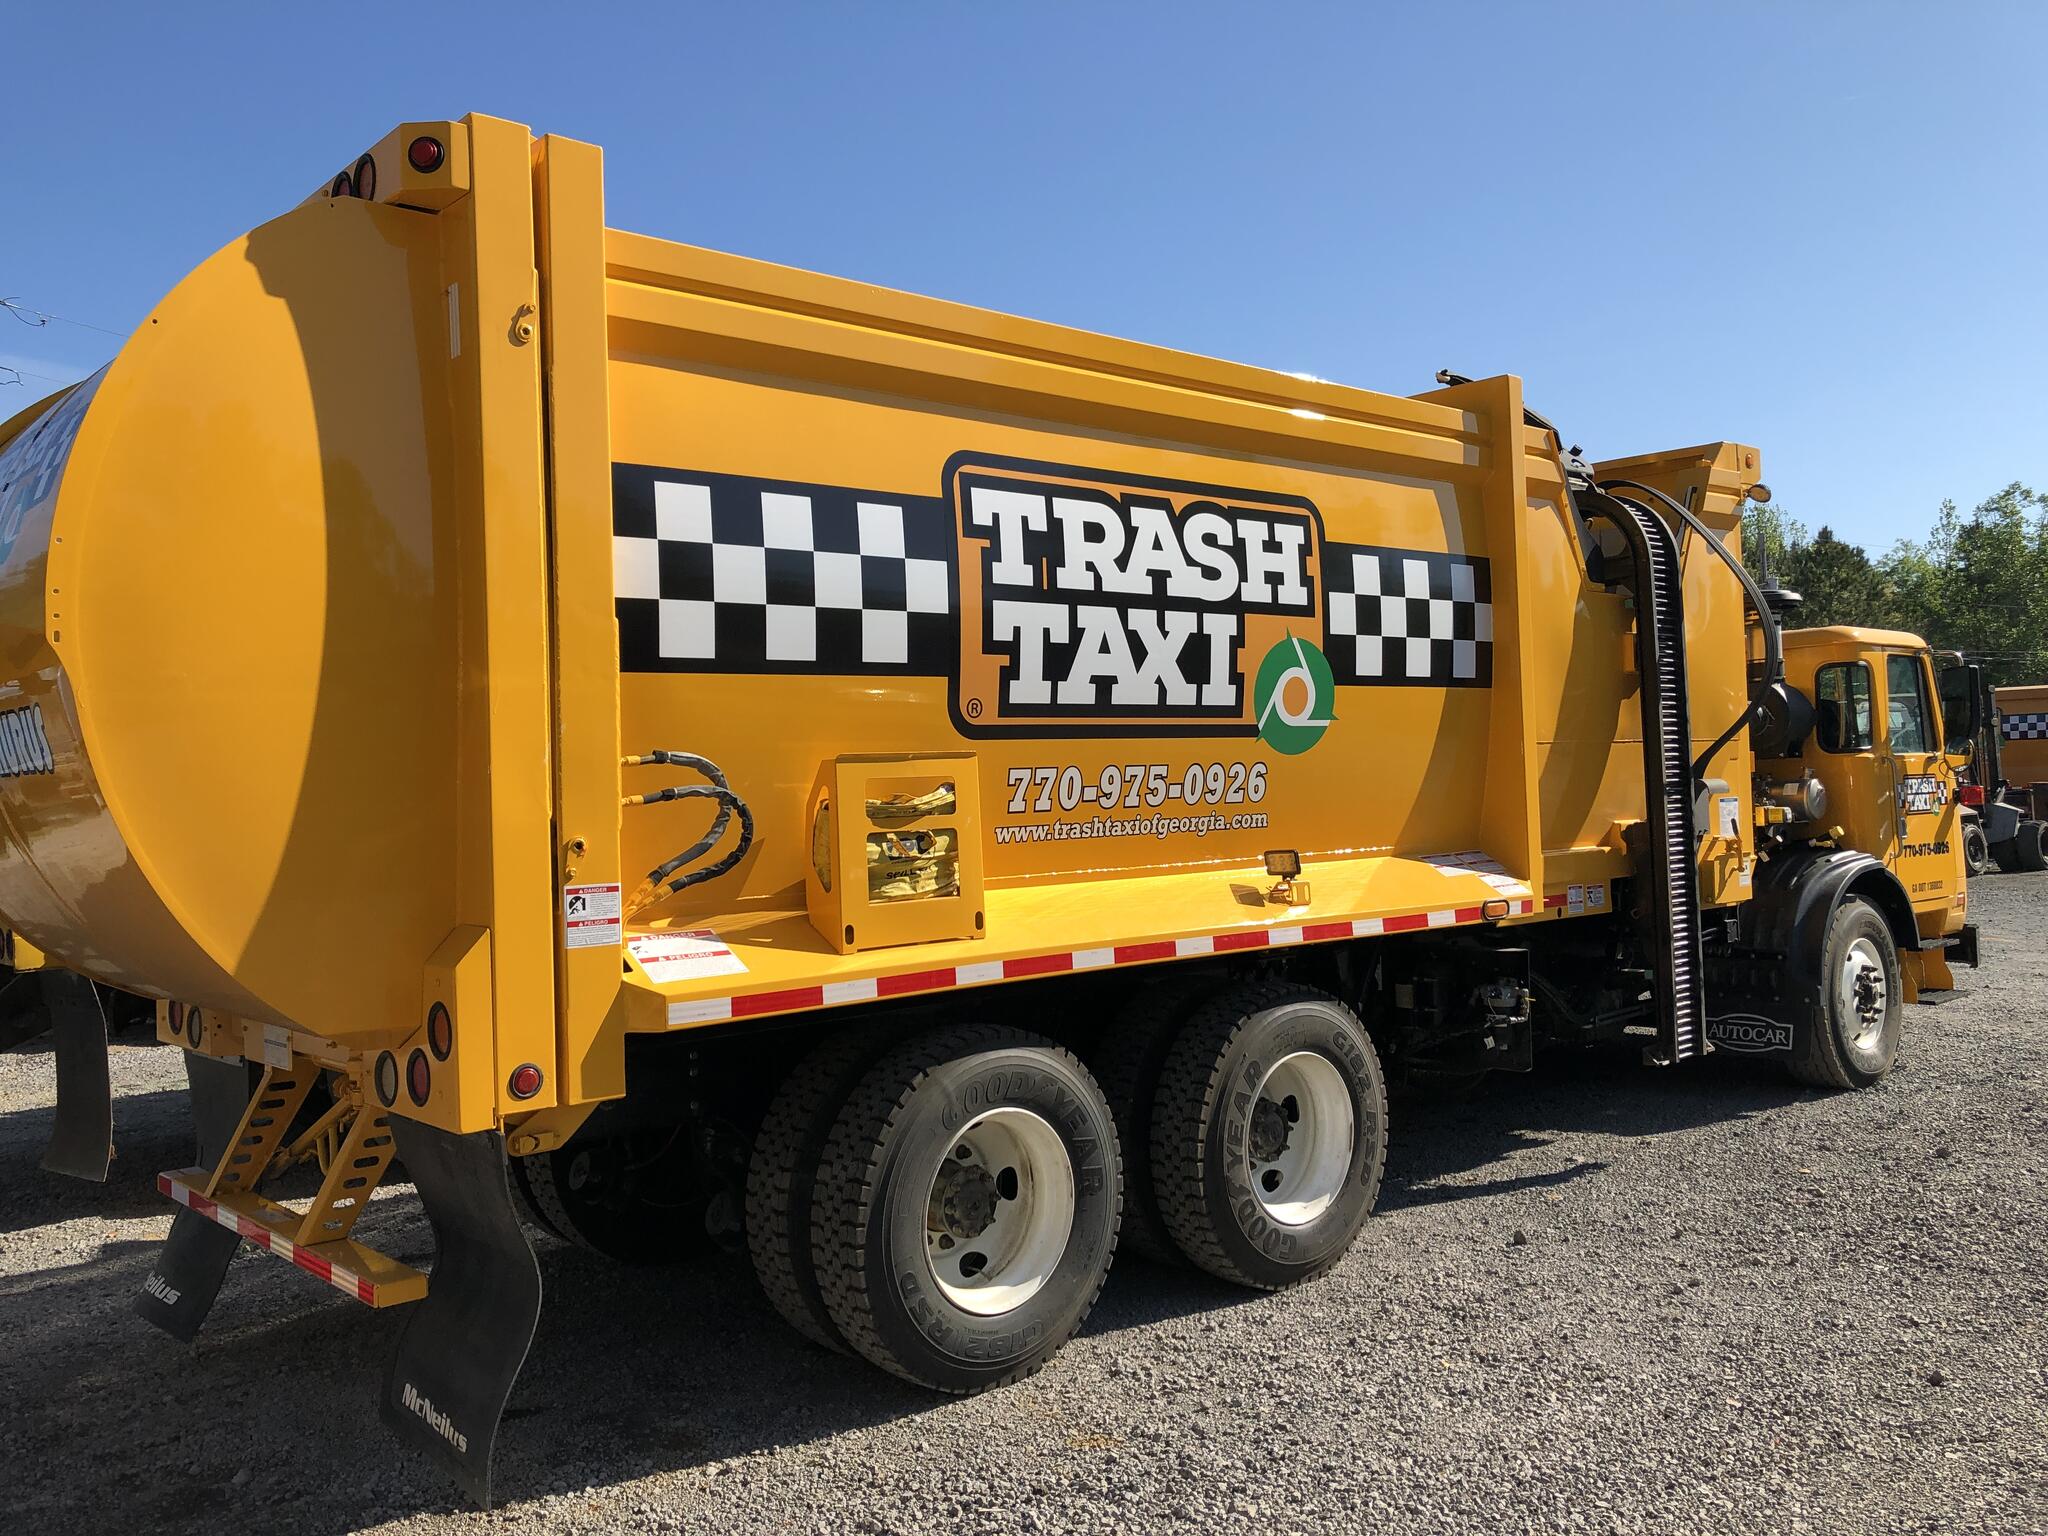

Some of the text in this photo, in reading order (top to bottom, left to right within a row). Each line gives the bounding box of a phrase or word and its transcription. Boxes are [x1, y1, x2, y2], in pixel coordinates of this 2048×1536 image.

[969, 486, 1309, 606] TRASH
[992, 599, 1238, 706] TAXI
[1007, 761, 1268, 814] 770-975-0926
[1904, 778, 1937, 794] TRASH
[1906, 793, 1931, 812] TAXI
[995, 810, 1269, 844] www.trashtaxiofgeorgia.com
[1903, 841, 1950, 859] 770-975-0926
[650, 932, 696, 940] DANGER
[669, 951, 714, 960] PELIGRO
[1708, 1023, 1788, 1045] AUTOCAR
[402, 1383, 468, 1453] McNeilus
